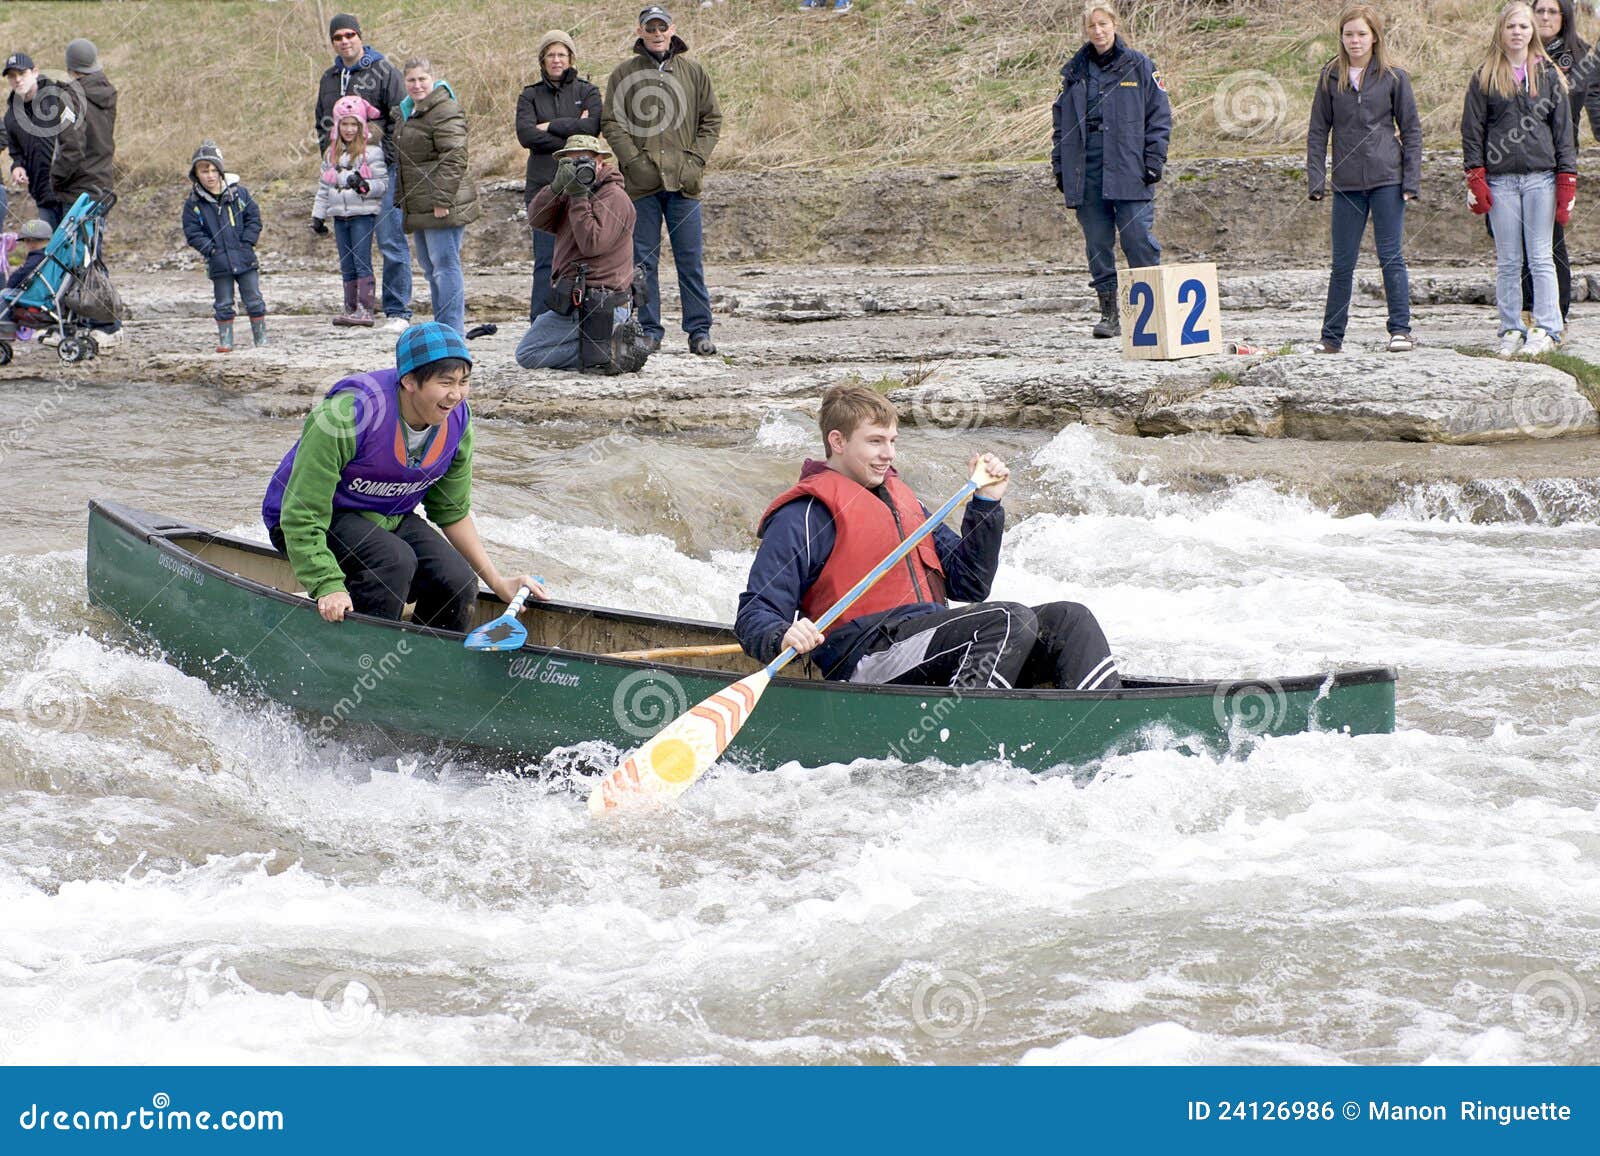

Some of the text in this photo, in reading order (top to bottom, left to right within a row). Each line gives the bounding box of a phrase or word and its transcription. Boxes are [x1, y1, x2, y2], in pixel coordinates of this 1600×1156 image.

[1129, 281, 1158, 347] 2
[1177, 278, 1210, 346] 2
[159, 553, 194, 581] DISCOVERY
[508, 656, 580, 688] Old Town
